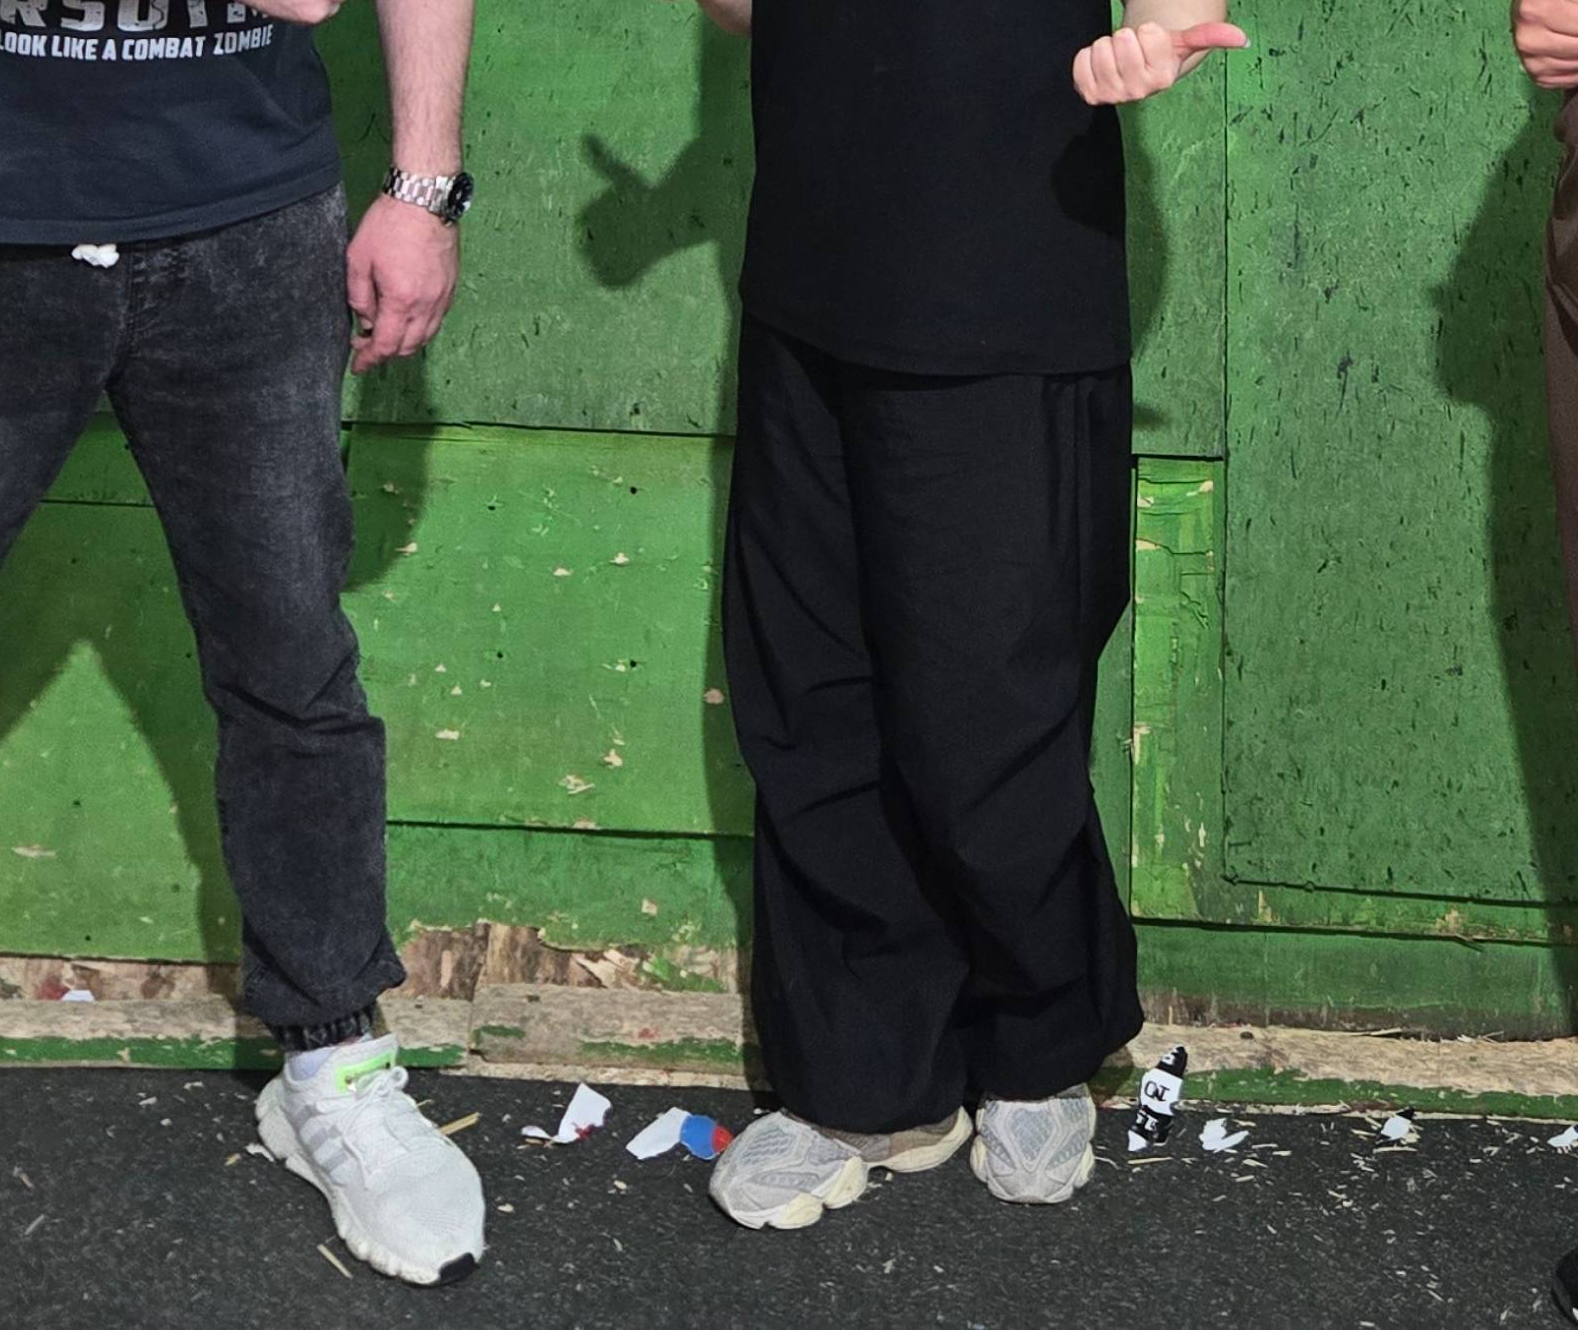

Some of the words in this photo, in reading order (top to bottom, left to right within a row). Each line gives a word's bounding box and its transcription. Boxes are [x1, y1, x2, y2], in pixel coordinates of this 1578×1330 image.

[51, 35, 97, 61] LIKE
[102, 38, 117, 61] A
[122, 35, 206, 61] COMBAT
[213, 24, 274, 56] ZOMBIE
